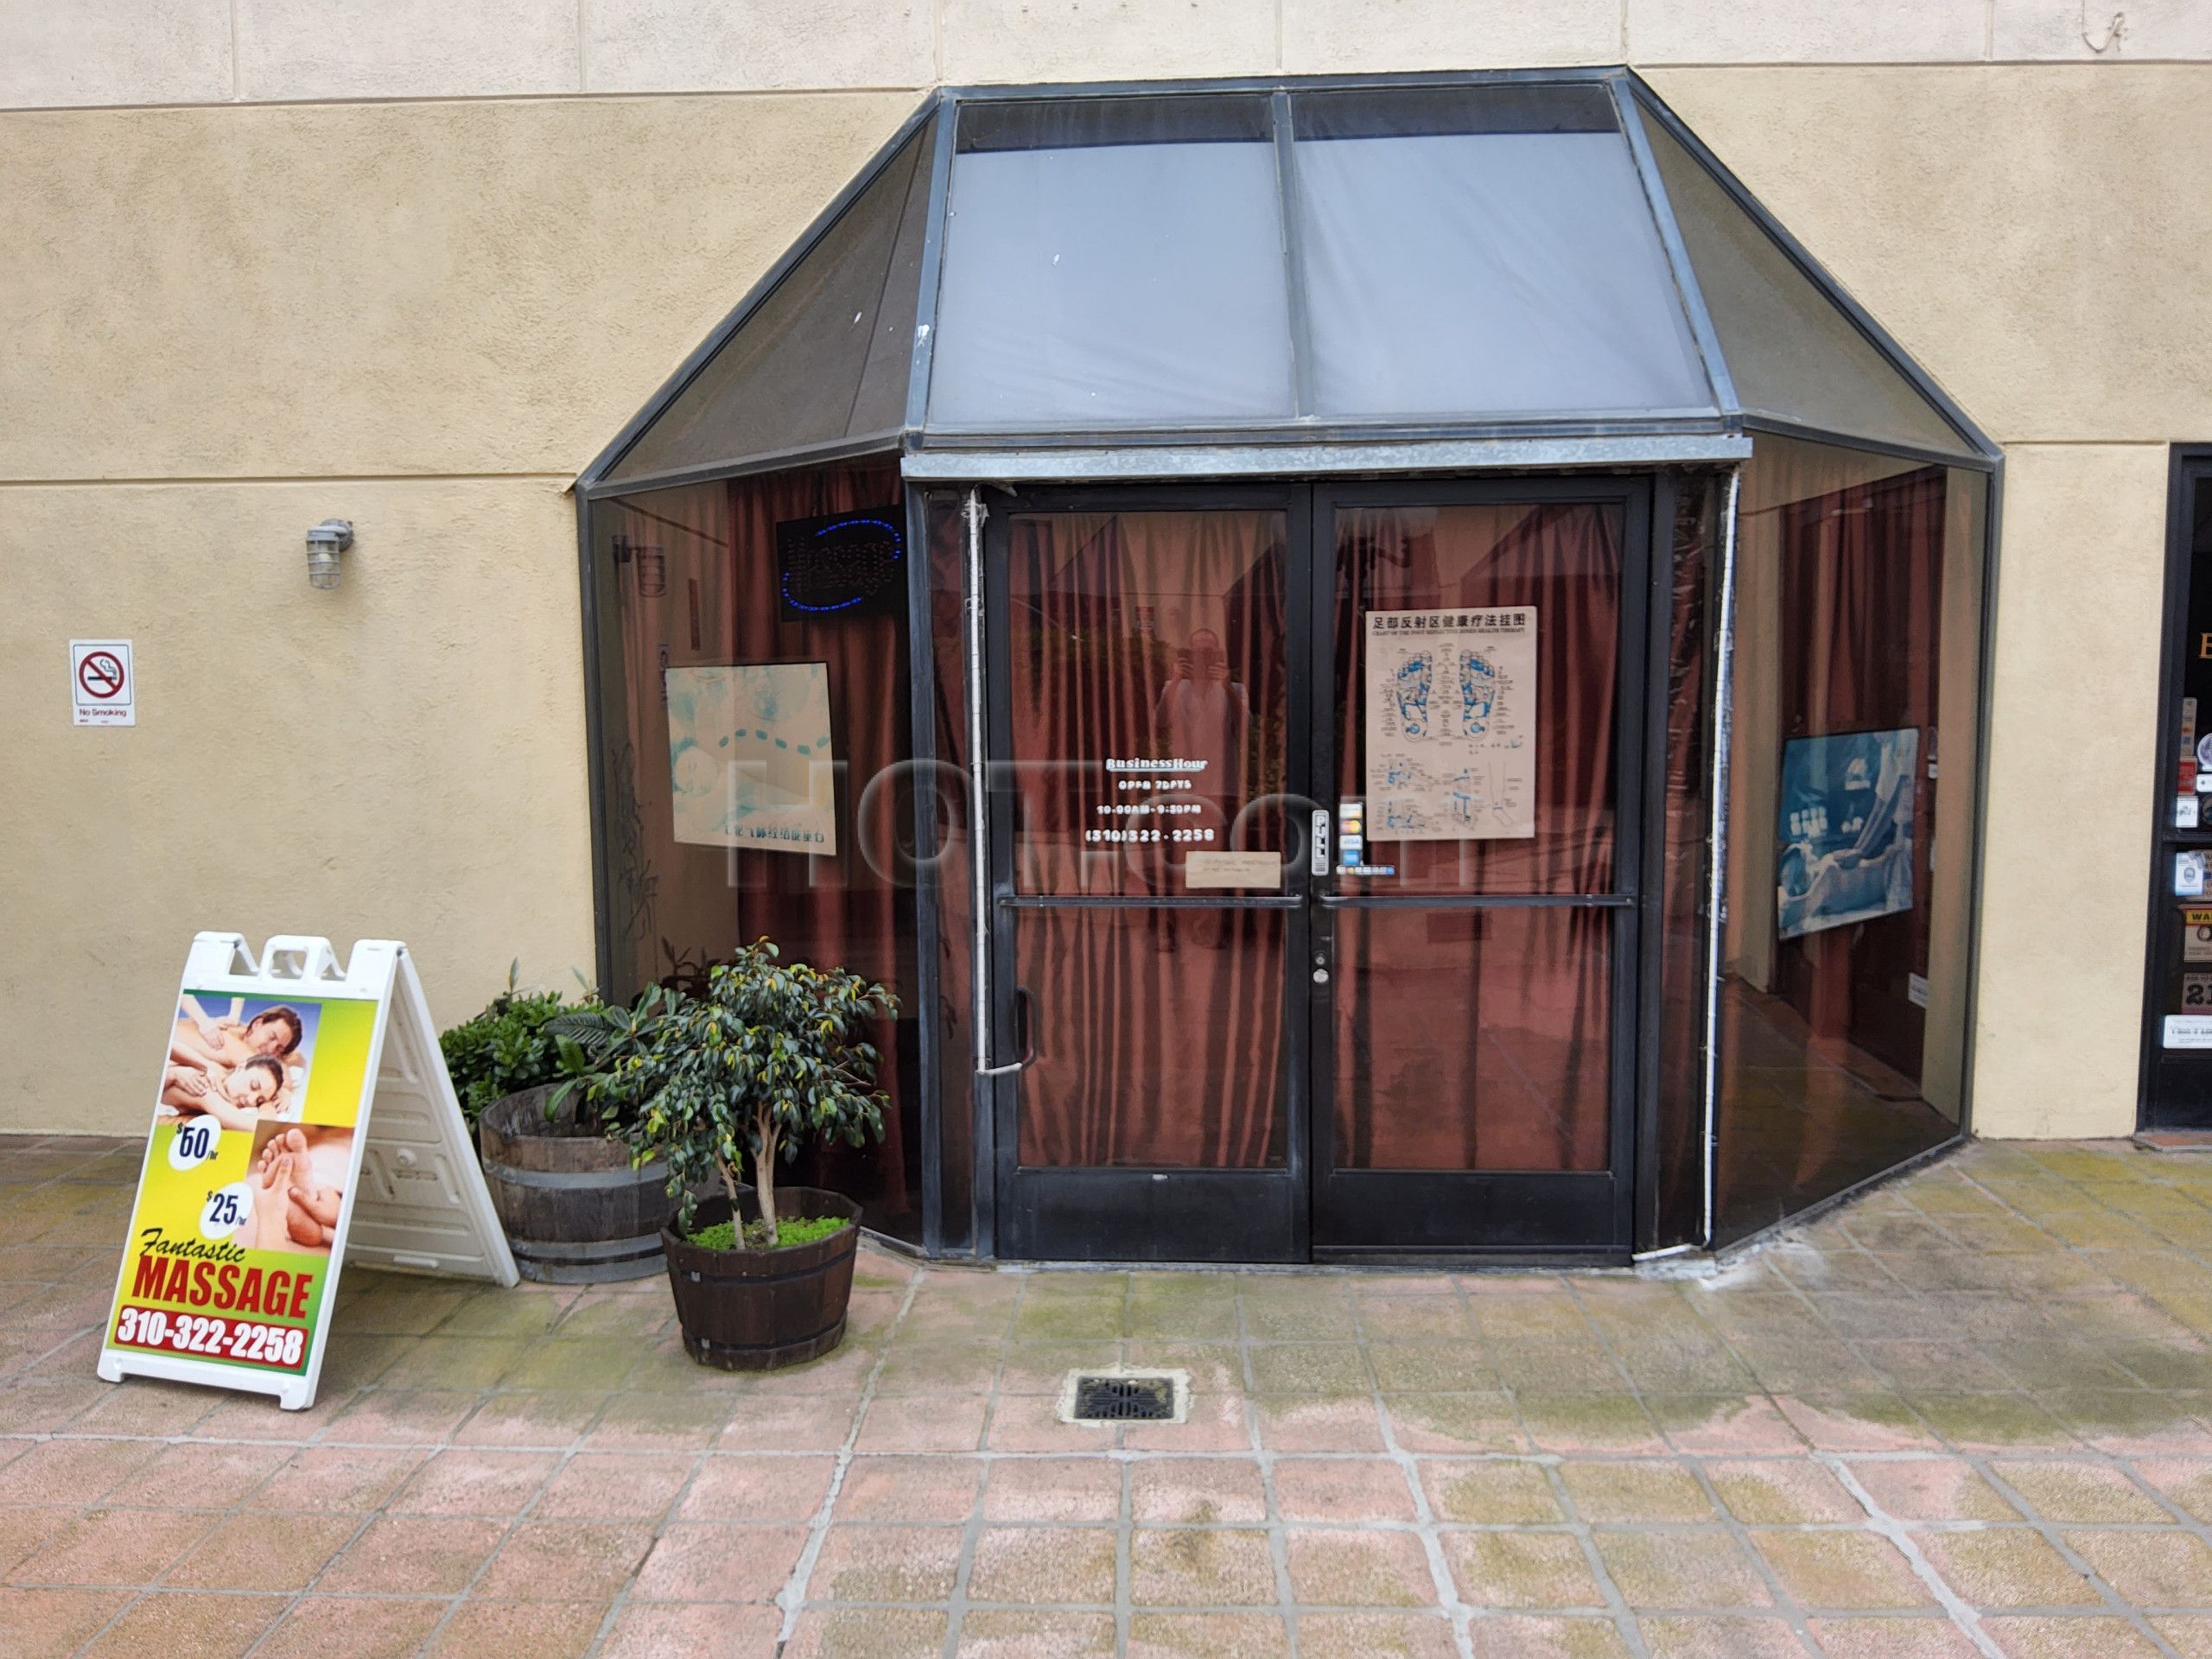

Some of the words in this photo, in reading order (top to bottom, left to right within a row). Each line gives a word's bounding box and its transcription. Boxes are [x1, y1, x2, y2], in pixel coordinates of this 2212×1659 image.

[1373, 613, 1526, 630] 足部反射区健康疗法挂图
[92, 709, 127, 717] Smoking
[1315, 815, 1326, 859] PULL
[140, 1227, 246, 1262] Fantastic
[131, 1255, 314, 1320] MASSAGE
[117, 1307, 304, 1365] 310-322-2258
